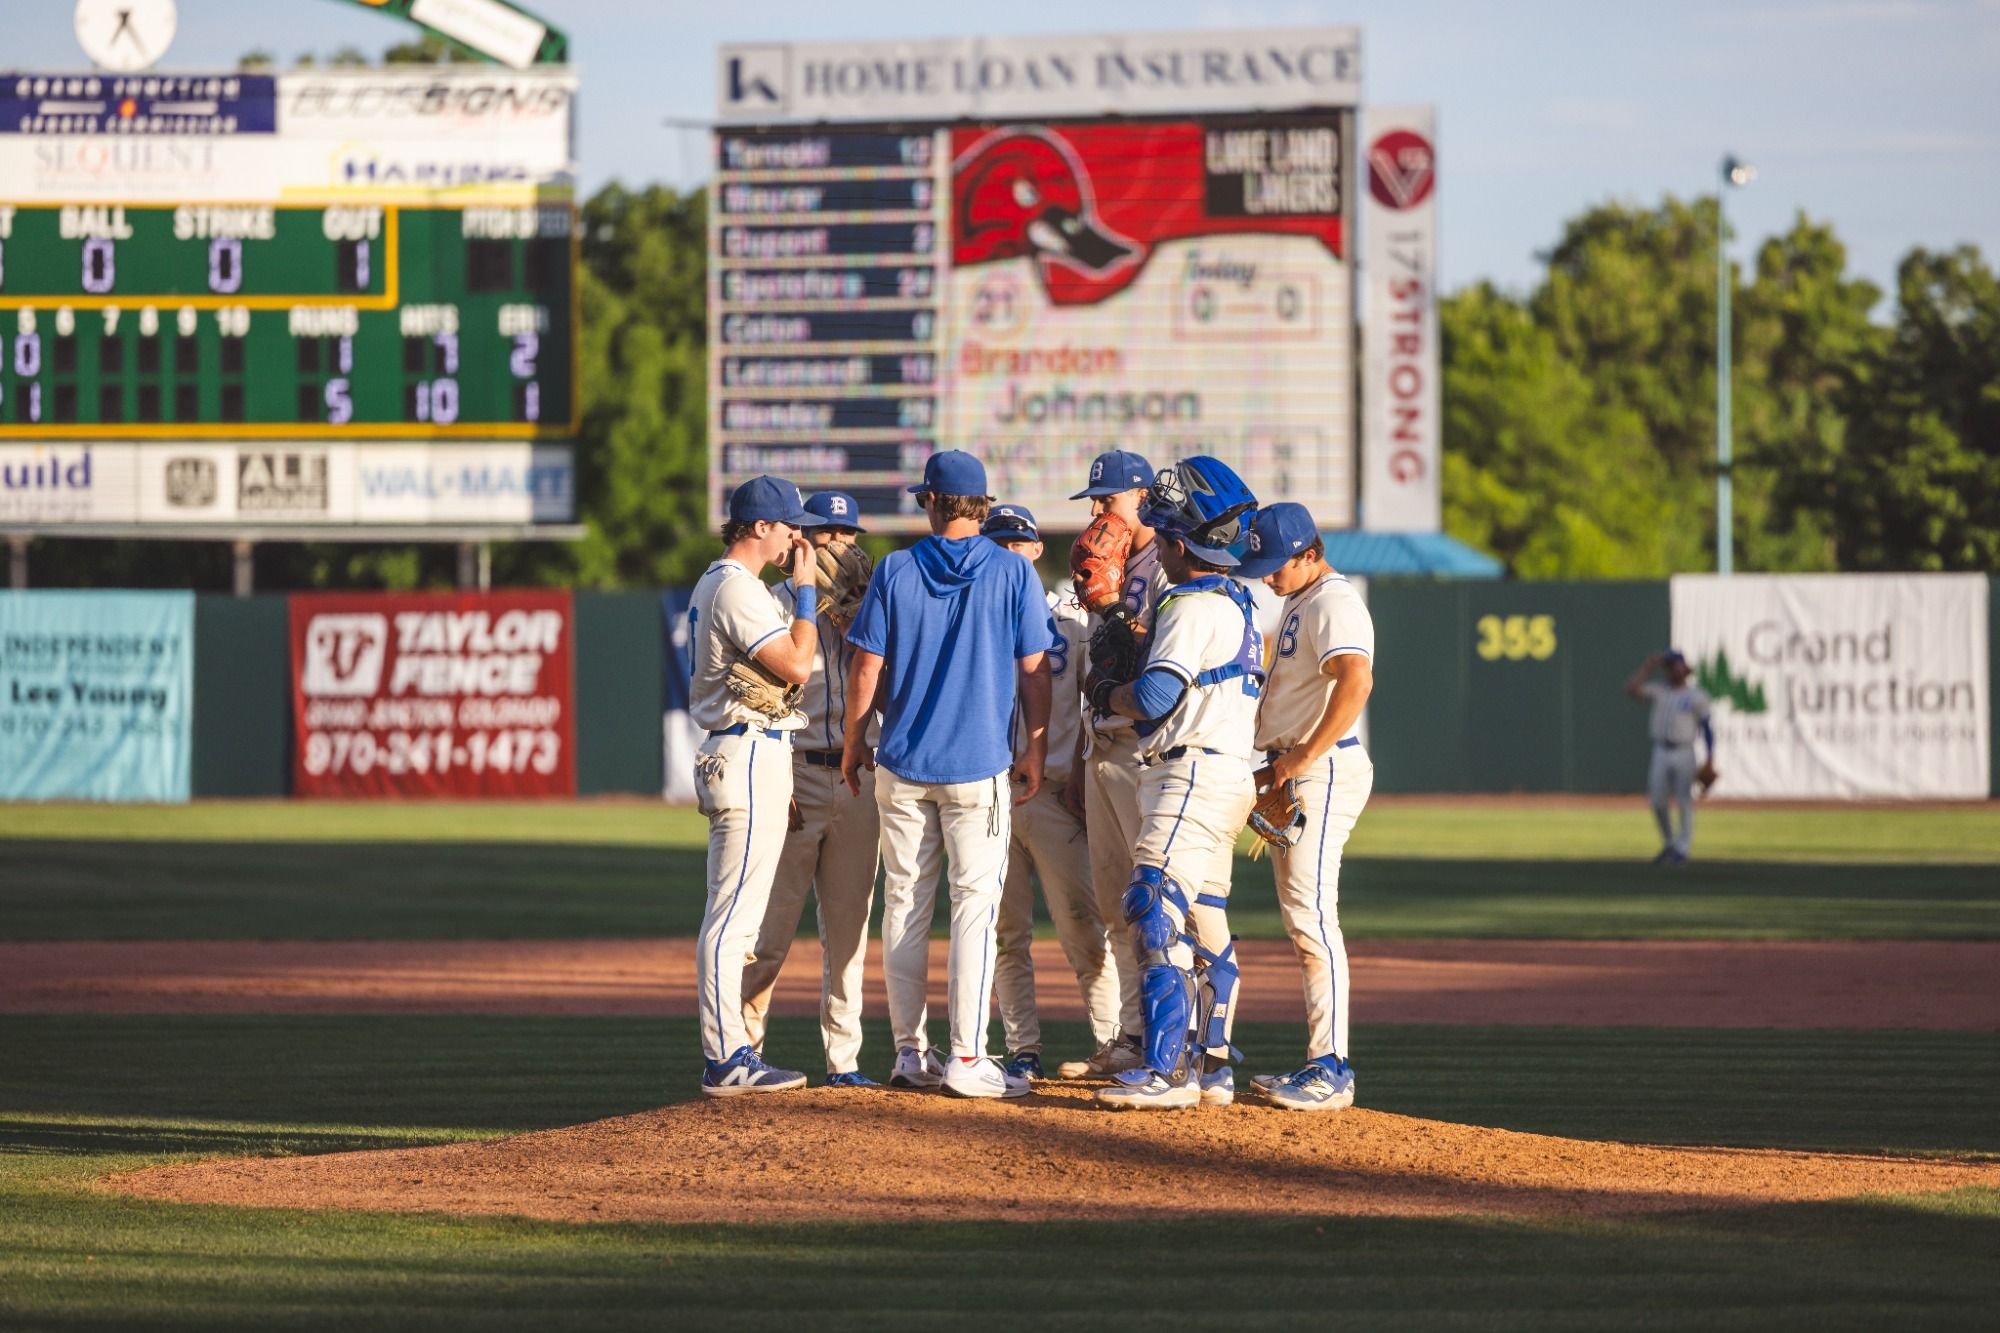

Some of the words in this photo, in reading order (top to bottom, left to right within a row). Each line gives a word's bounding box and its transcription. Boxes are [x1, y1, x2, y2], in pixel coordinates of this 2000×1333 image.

[803, 58, 937, 97] HOME
[953, 52, 1077, 93] LOAN
[1095, 44, 1358, 86] INSURANCE
[59, 205, 133, 240] BALL
[173, 205, 276, 240] STRIKE
[322, 206, 383, 241] OUT
[81, 236, 115, 293] 0
[208, 236, 242, 293] 0
[355, 238, 370, 290] 1
[17, 303, 37, 336] 5
[102, 303, 121, 337] 7
[214, 303, 250, 338] 10
[289, 303, 359, 338] RUNS
[400, 303, 459, 338] HITS
[14, 333, 41, 377] 0
[339, 334, 353, 374] 1
[432, 330, 459, 374] 7
[510, 331, 539, 378] 2
[960, 340, 1121, 376] Brandon
[29, 381, 41, 422] 1
[325, 377, 353, 425] 5
[416, 377, 459, 425] 10
[525, 380, 540, 422] 1
[994, 382, 1201, 424] Johnson
[1090, 460, 1104, 482] B
[830, 496, 848, 515] B
[1125, 575, 1148, 618] B
[5, 636, 179, 654] INDEPENDENT
[394, 609, 563, 655] TAYLOR
[1279, 613, 1300, 659] B
[1476, 614, 1556, 661] 355
[1746, 619, 1892, 666] Grand
[389, 653, 543, 695] FENCE
[12, 680, 60, 703] Lee
[72, 681, 166, 712] Young
[1784, 670, 1976, 722] Junction
[304, 729, 561, 776] 970-241-1473
